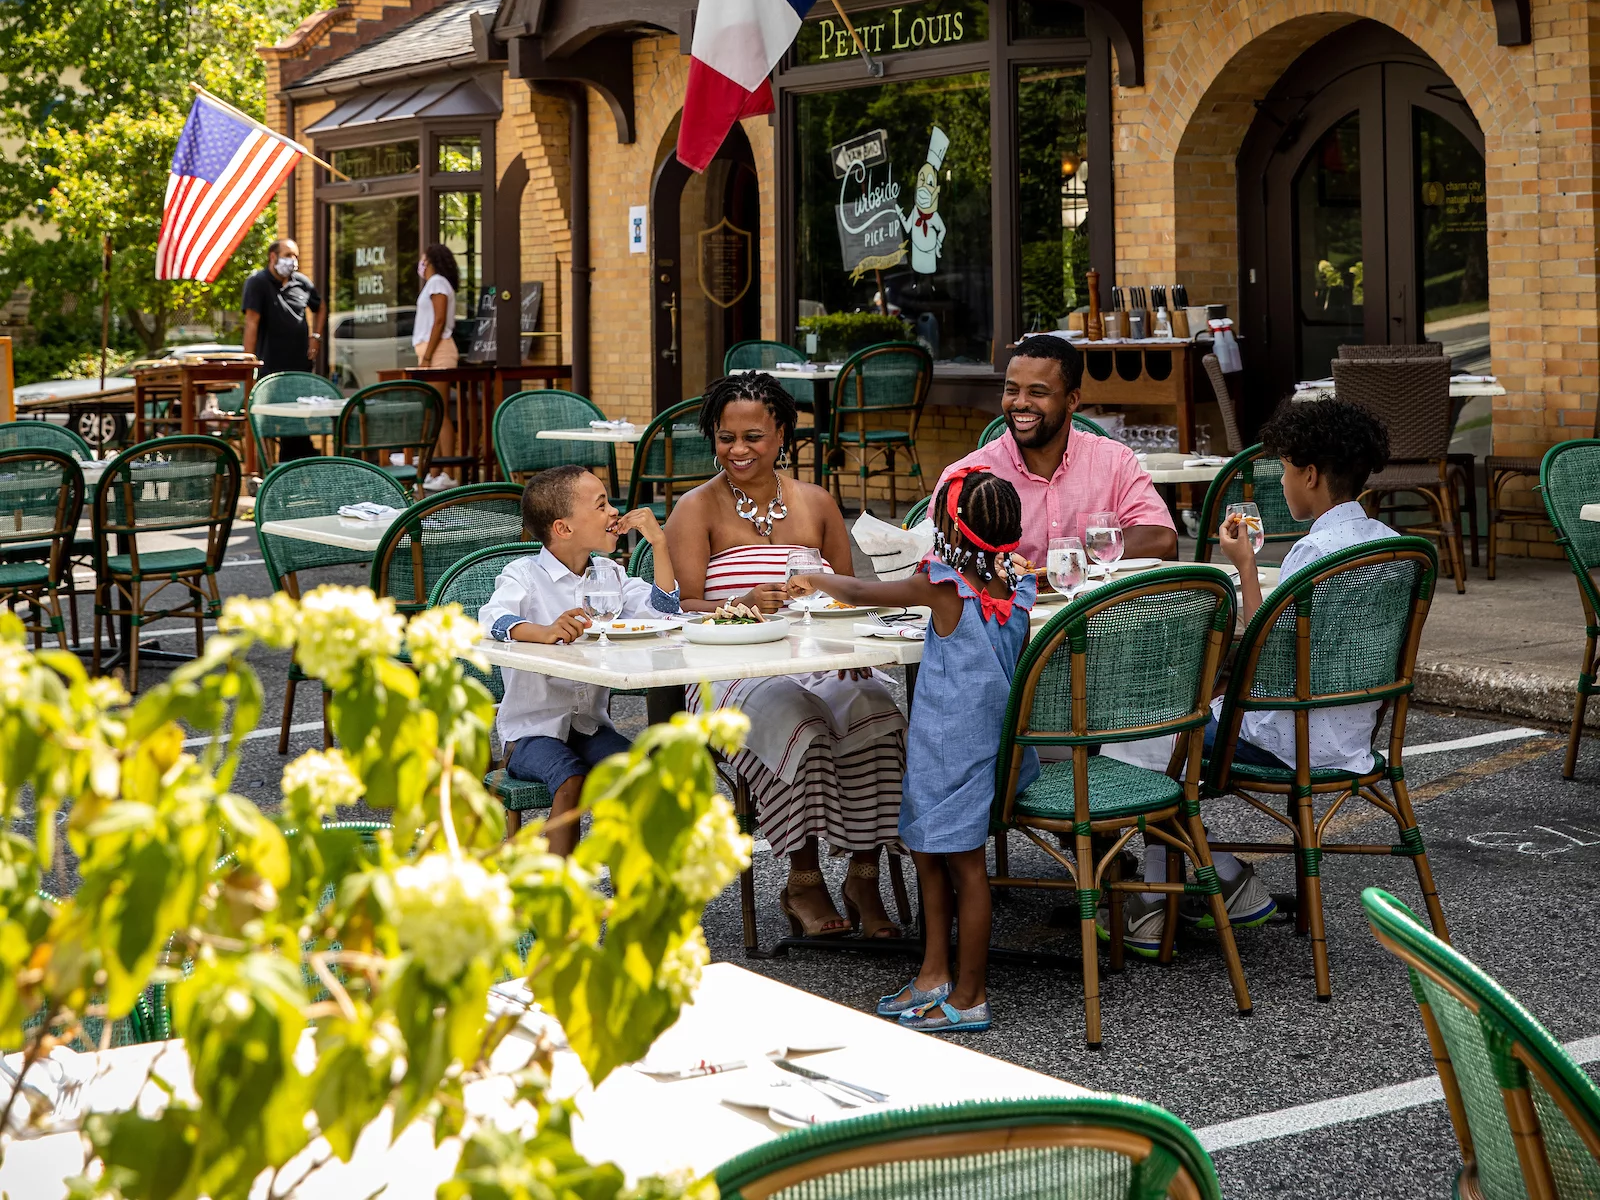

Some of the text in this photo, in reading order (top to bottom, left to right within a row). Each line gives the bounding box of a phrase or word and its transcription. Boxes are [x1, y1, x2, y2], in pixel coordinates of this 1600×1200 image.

[892, 8, 964, 49] LOUIS
[840, 159, 901, 234] Curbside
[864, 219, 900, 248] PICK-UP
[356, 246, 386, 267] BLACK
[358, 275, 383, 295] LIVES
[354, 303, 388, 324] MATTER
